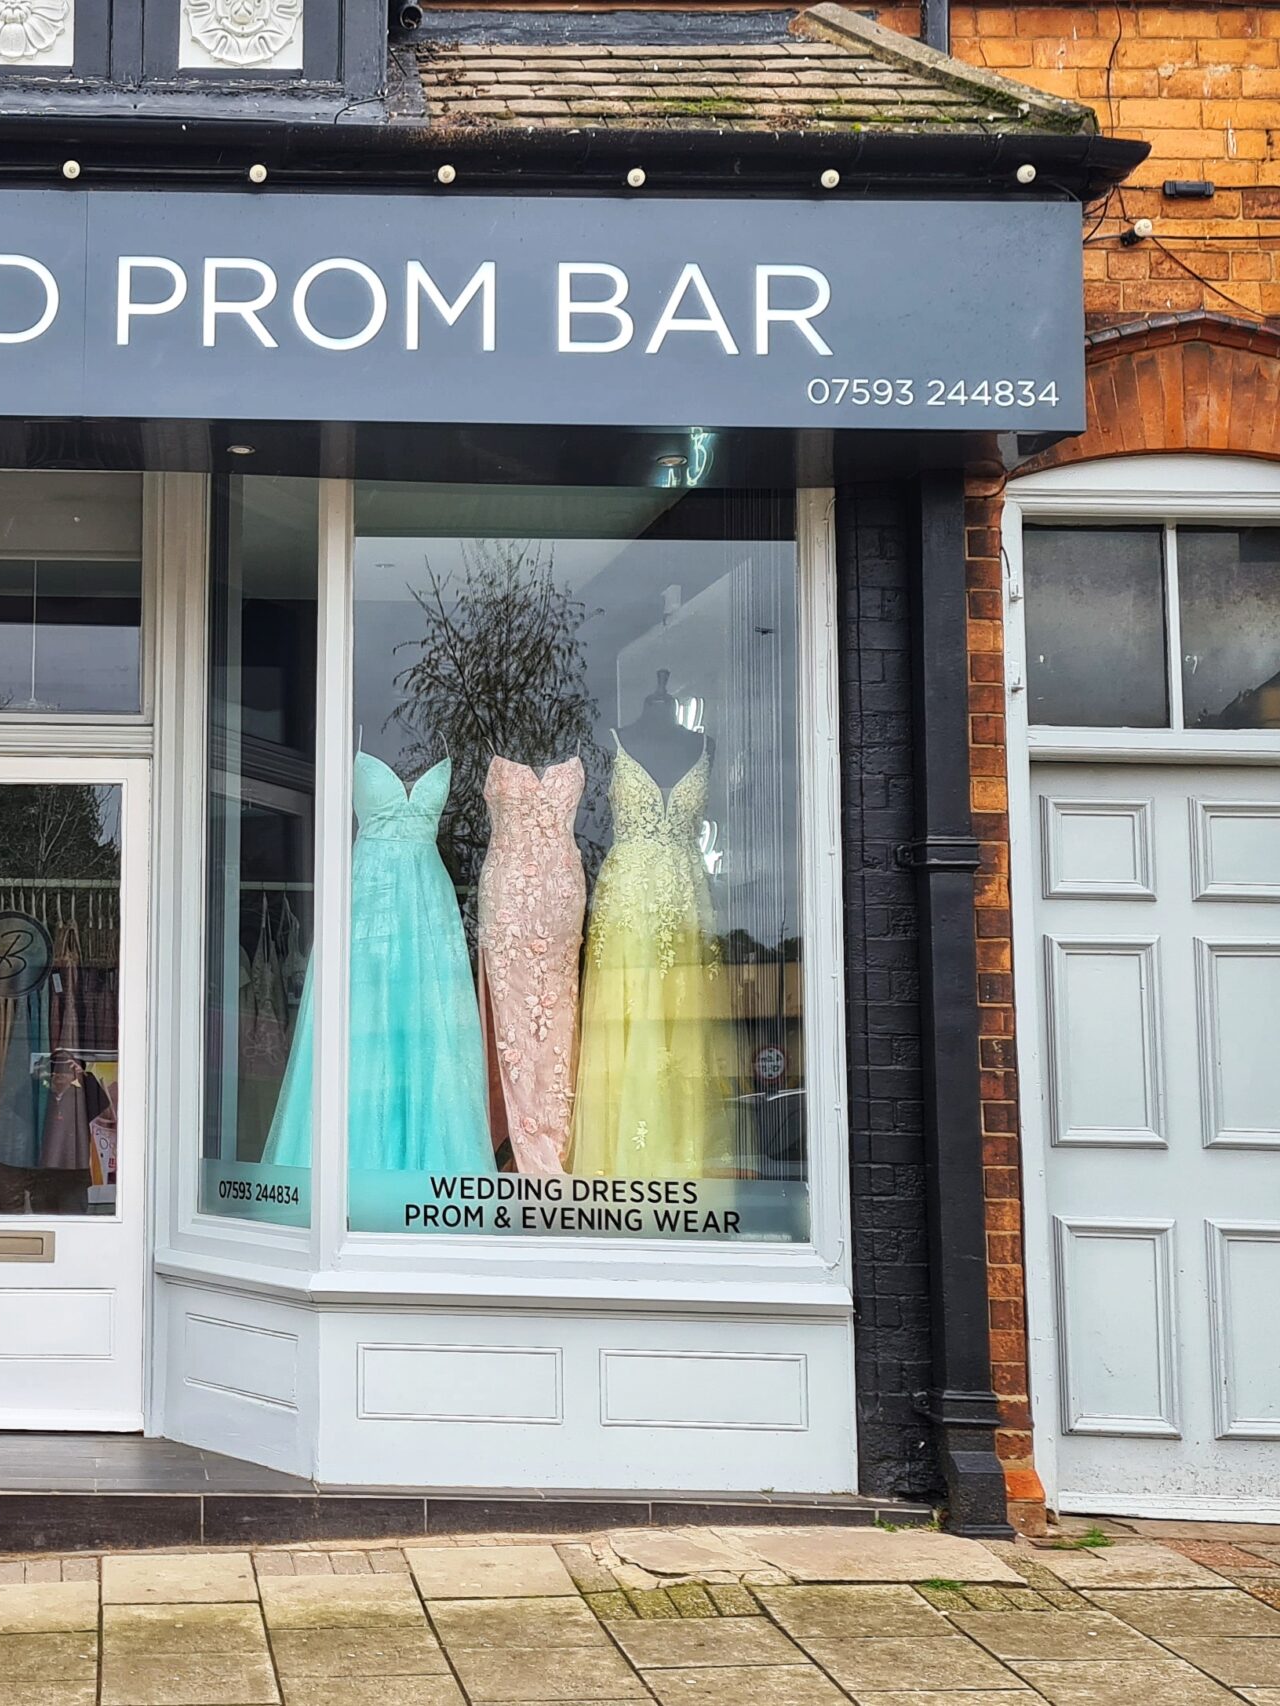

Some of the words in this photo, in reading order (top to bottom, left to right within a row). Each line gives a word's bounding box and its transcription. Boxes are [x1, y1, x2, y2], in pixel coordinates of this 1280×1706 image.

[116, 255, 496, 352] PROM
[557, 261, 834, 356] BAR
[807, 378, 914, 407] 07593
[926, 379, 1060, 408] 244834
[219, 1180, 252, 1200] 07593
[255, 1182, 299, 1206] 244834
[430, 1176, 563, 1202] WEDDING
[571, 1178, 698, 1205] DRESSES
[404, 1203, 485, 1229] PROM
[493, 1205, 512, 1230] &
[521, 1205, 641, 1232] EVENING
[660, 1208, 742, 1235] WEAR
